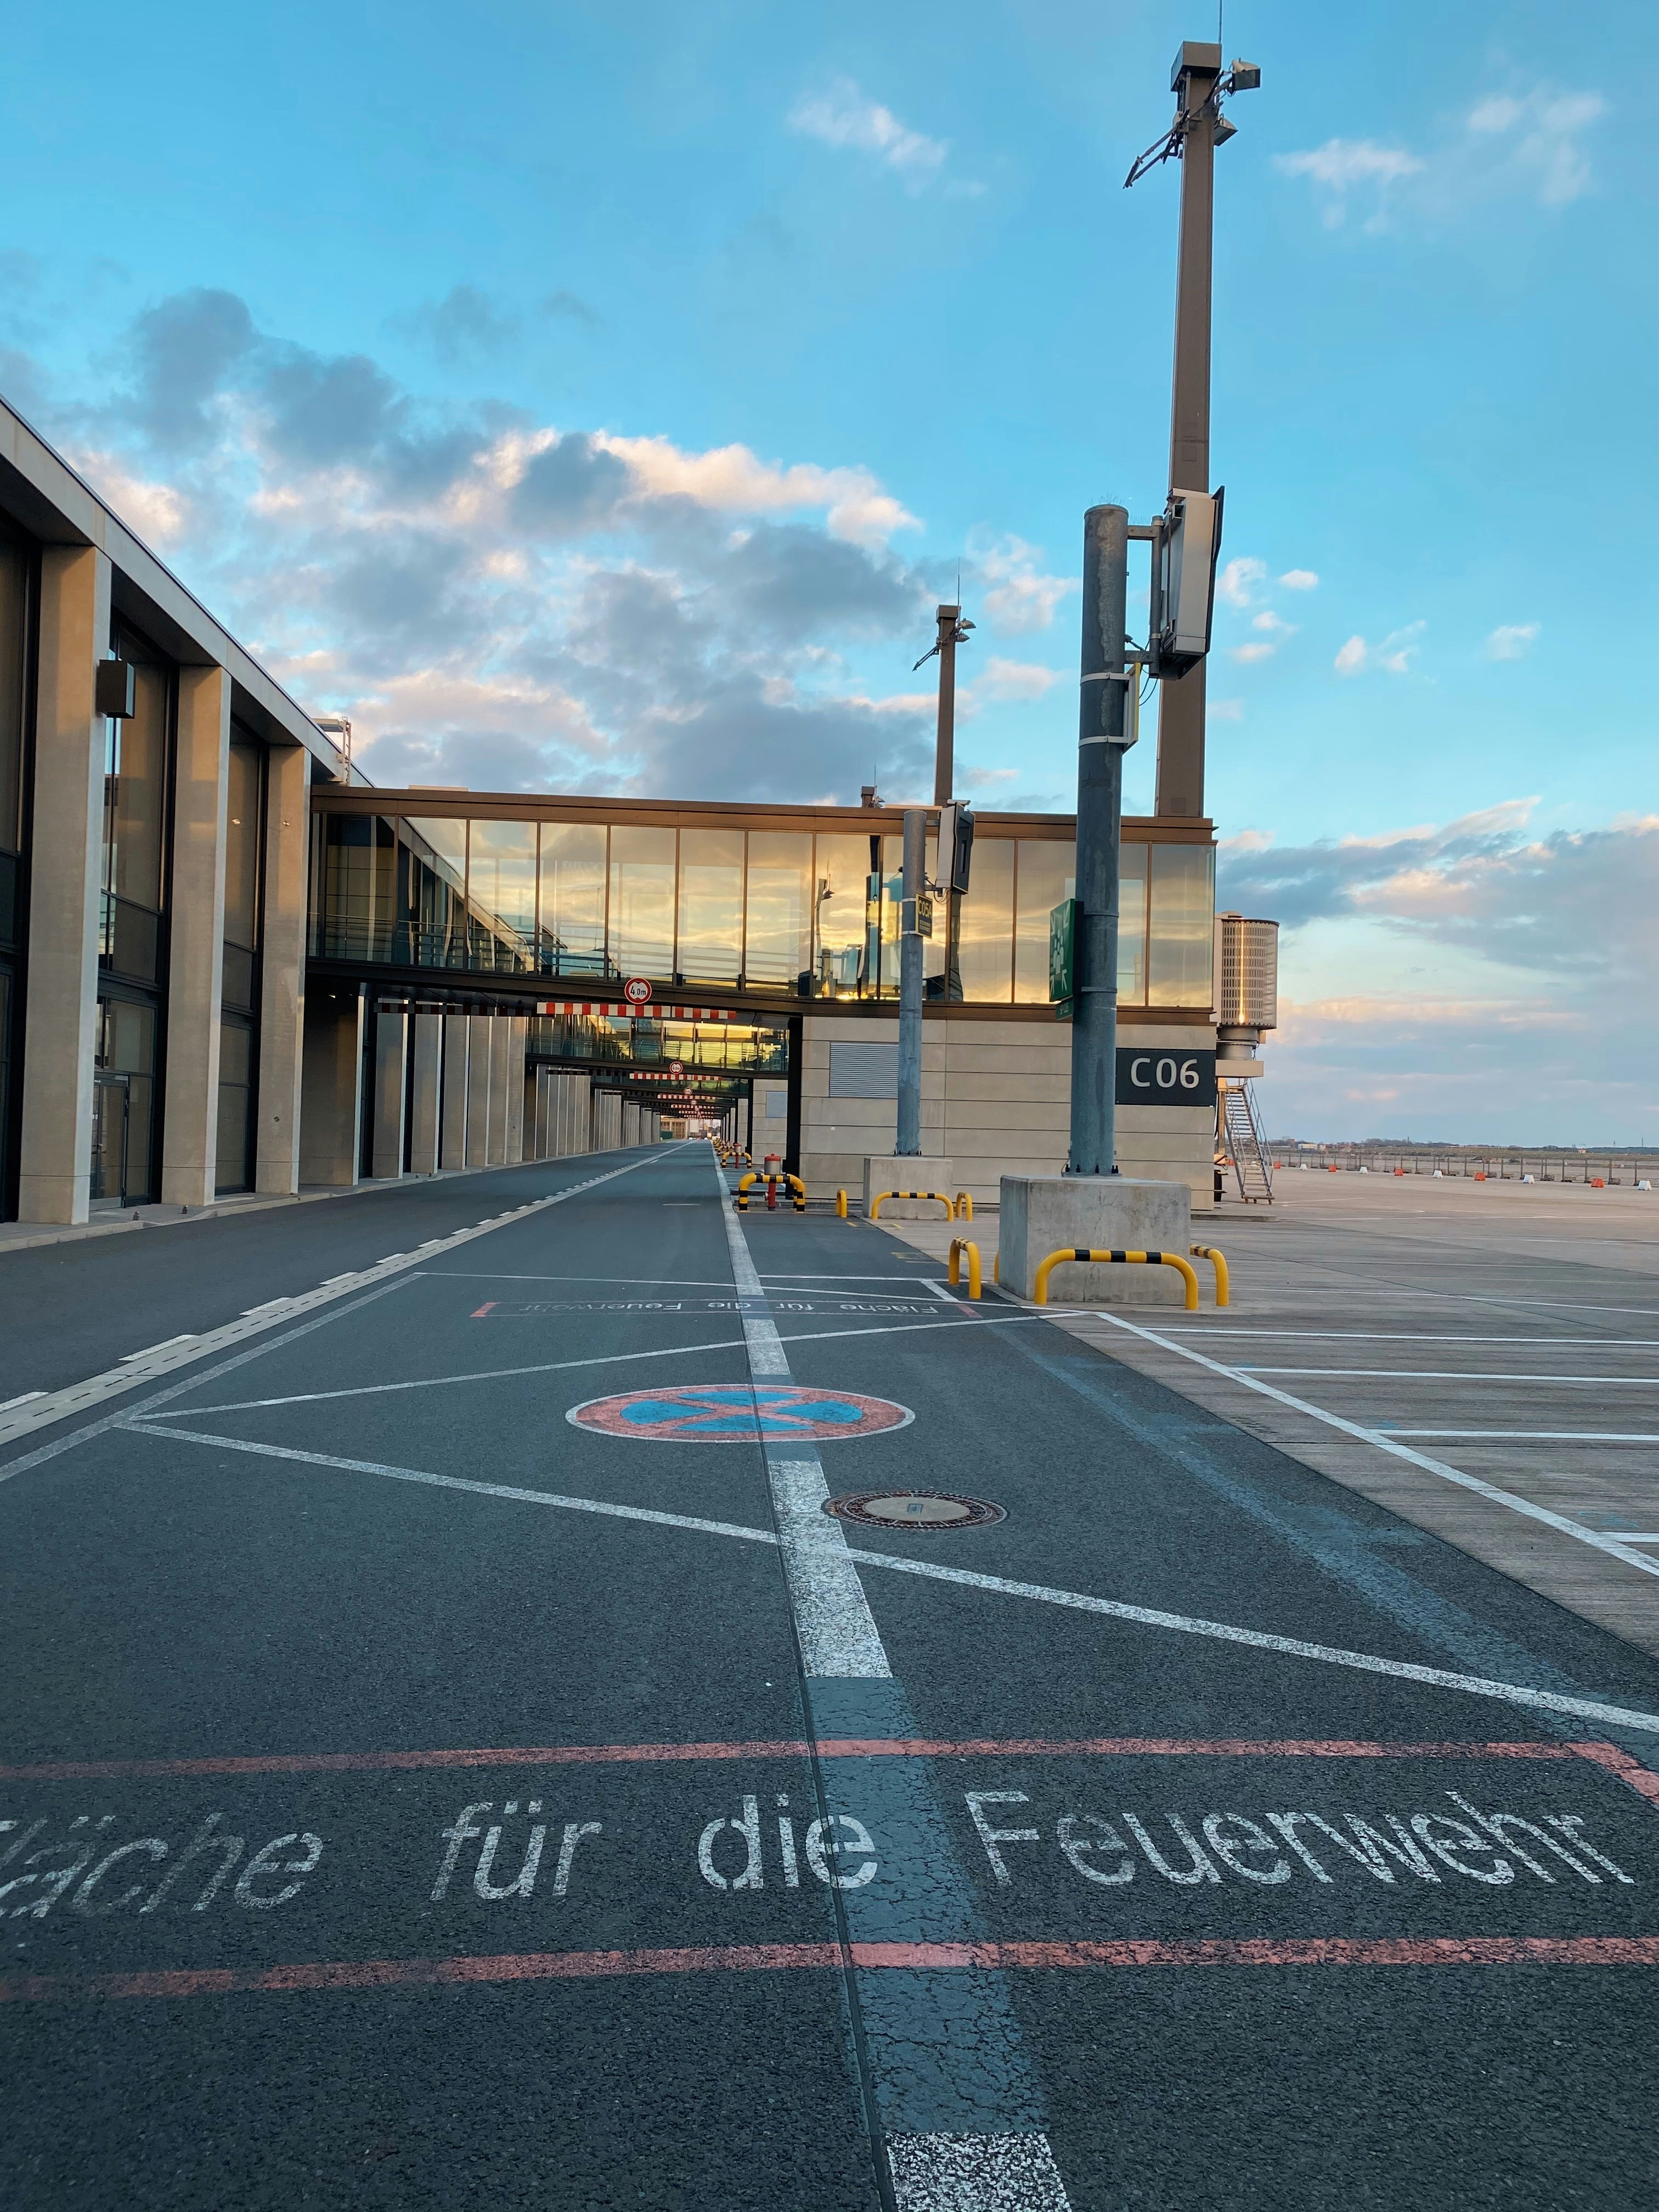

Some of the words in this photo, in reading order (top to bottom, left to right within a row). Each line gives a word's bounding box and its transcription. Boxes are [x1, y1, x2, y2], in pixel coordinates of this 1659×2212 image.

[1131, 1057, 1200, 1088] C06
[775, 1302, 815, 1311] für
[839, 1304, 939, 1314] Fläche
[430, 1799, 603, 1901] für
[697, 1794, 878, 1890] die
[964, 1790, 1635, 1887] Feuerwehr
